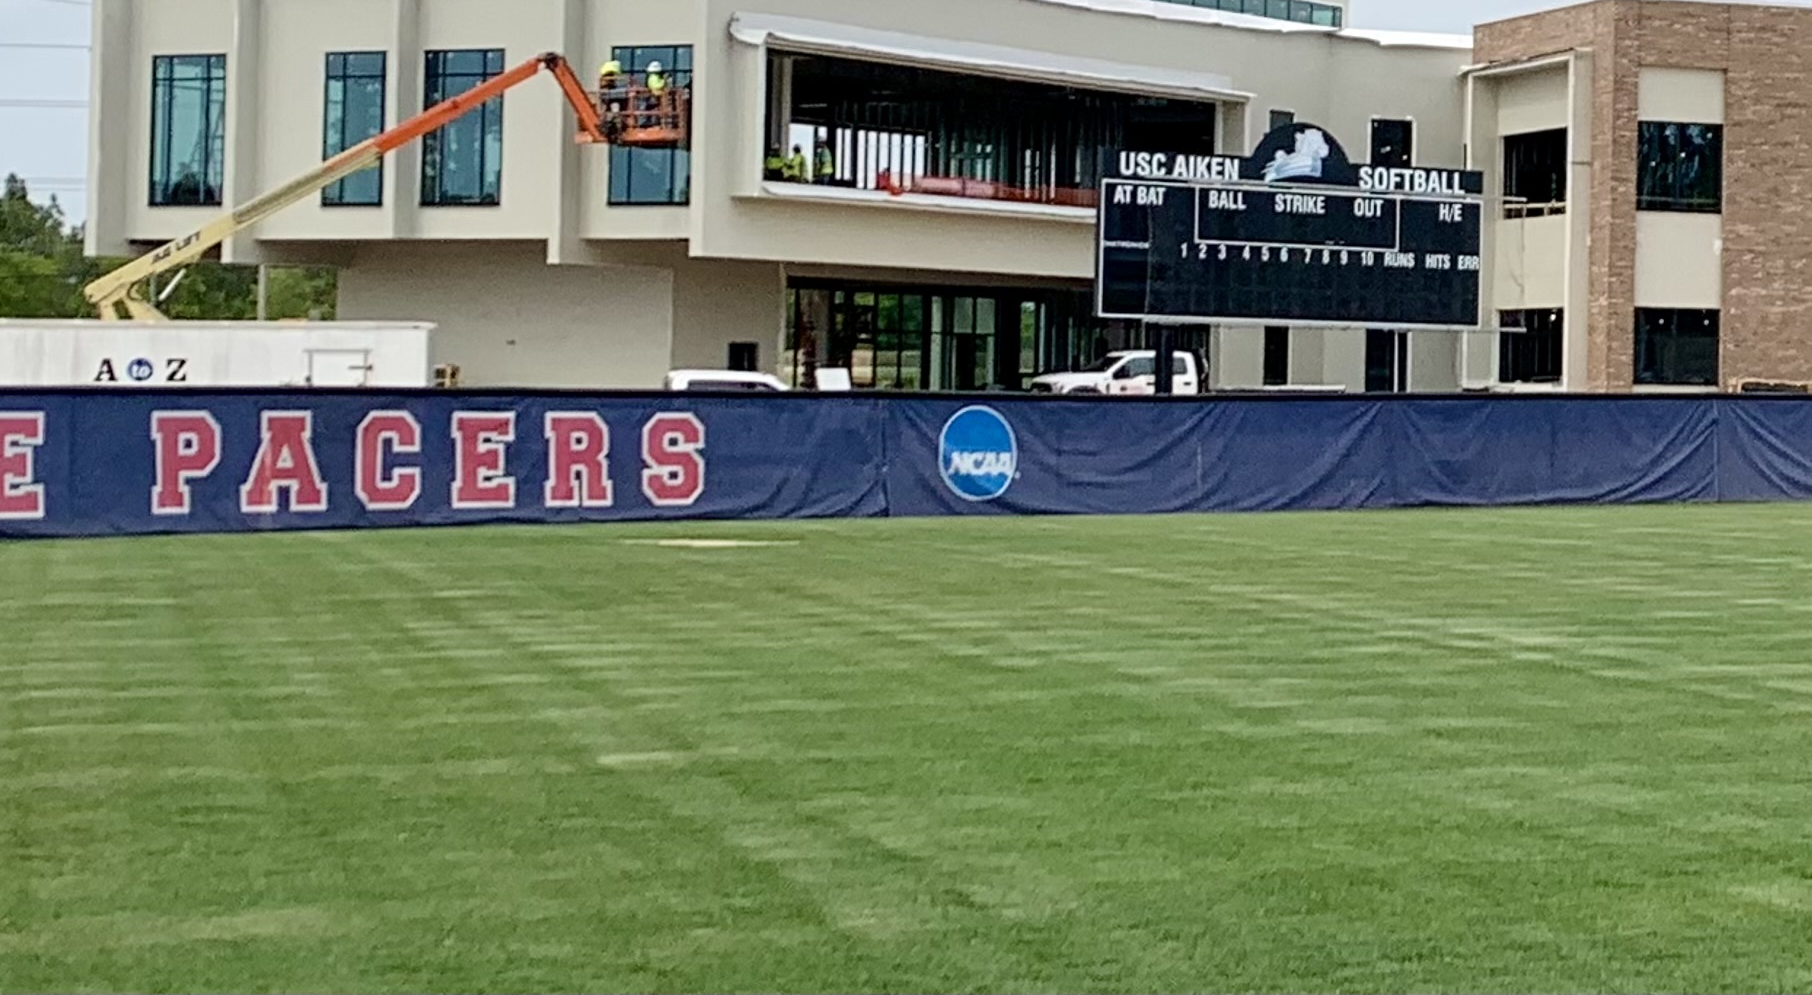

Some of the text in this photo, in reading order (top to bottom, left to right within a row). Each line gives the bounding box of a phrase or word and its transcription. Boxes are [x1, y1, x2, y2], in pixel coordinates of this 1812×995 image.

[1119, 151, 1240, 181] USC AIKEN
[1358, 166, 1466, 194] SOFTBALL
[1113, 185, 1167, 206] AT BAT
[1208, 190, 1247, 210] BALL
[1274, 193, 1326, 215] STRIKE
[1353, 197, 1384, 218] OUT
[1438, 203, 1463, 223] H/E
[1180, 242, 1480, 271] 1 2 3 4 5 6 7 8 9 10 RUNS HITS ERR
[94, 358, 118, 382] A
[166, 358, 187, 382] Z
[151, 409, 704, 515] PACERS
[948, 451, 1013, 476] NCAA
